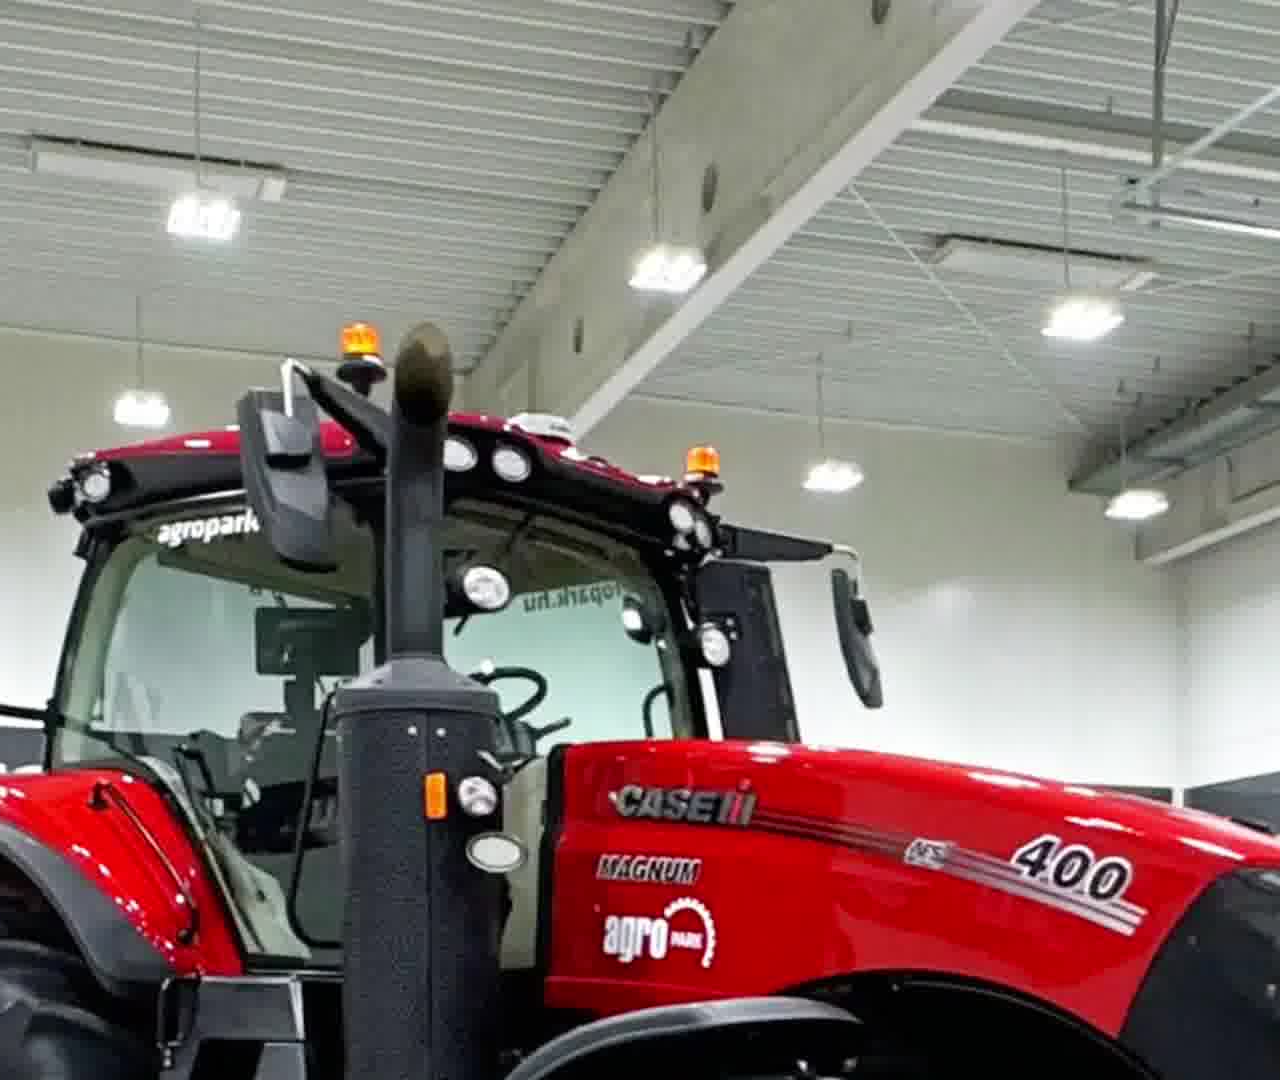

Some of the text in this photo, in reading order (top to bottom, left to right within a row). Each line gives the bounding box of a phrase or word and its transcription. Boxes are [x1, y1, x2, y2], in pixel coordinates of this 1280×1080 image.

[608, 784, 719, 822] CASE
[596, 853, 702, 885] MAGNUM
[1011, 835, 1132, 901] 400
[603, 915, 669, 963] agro
